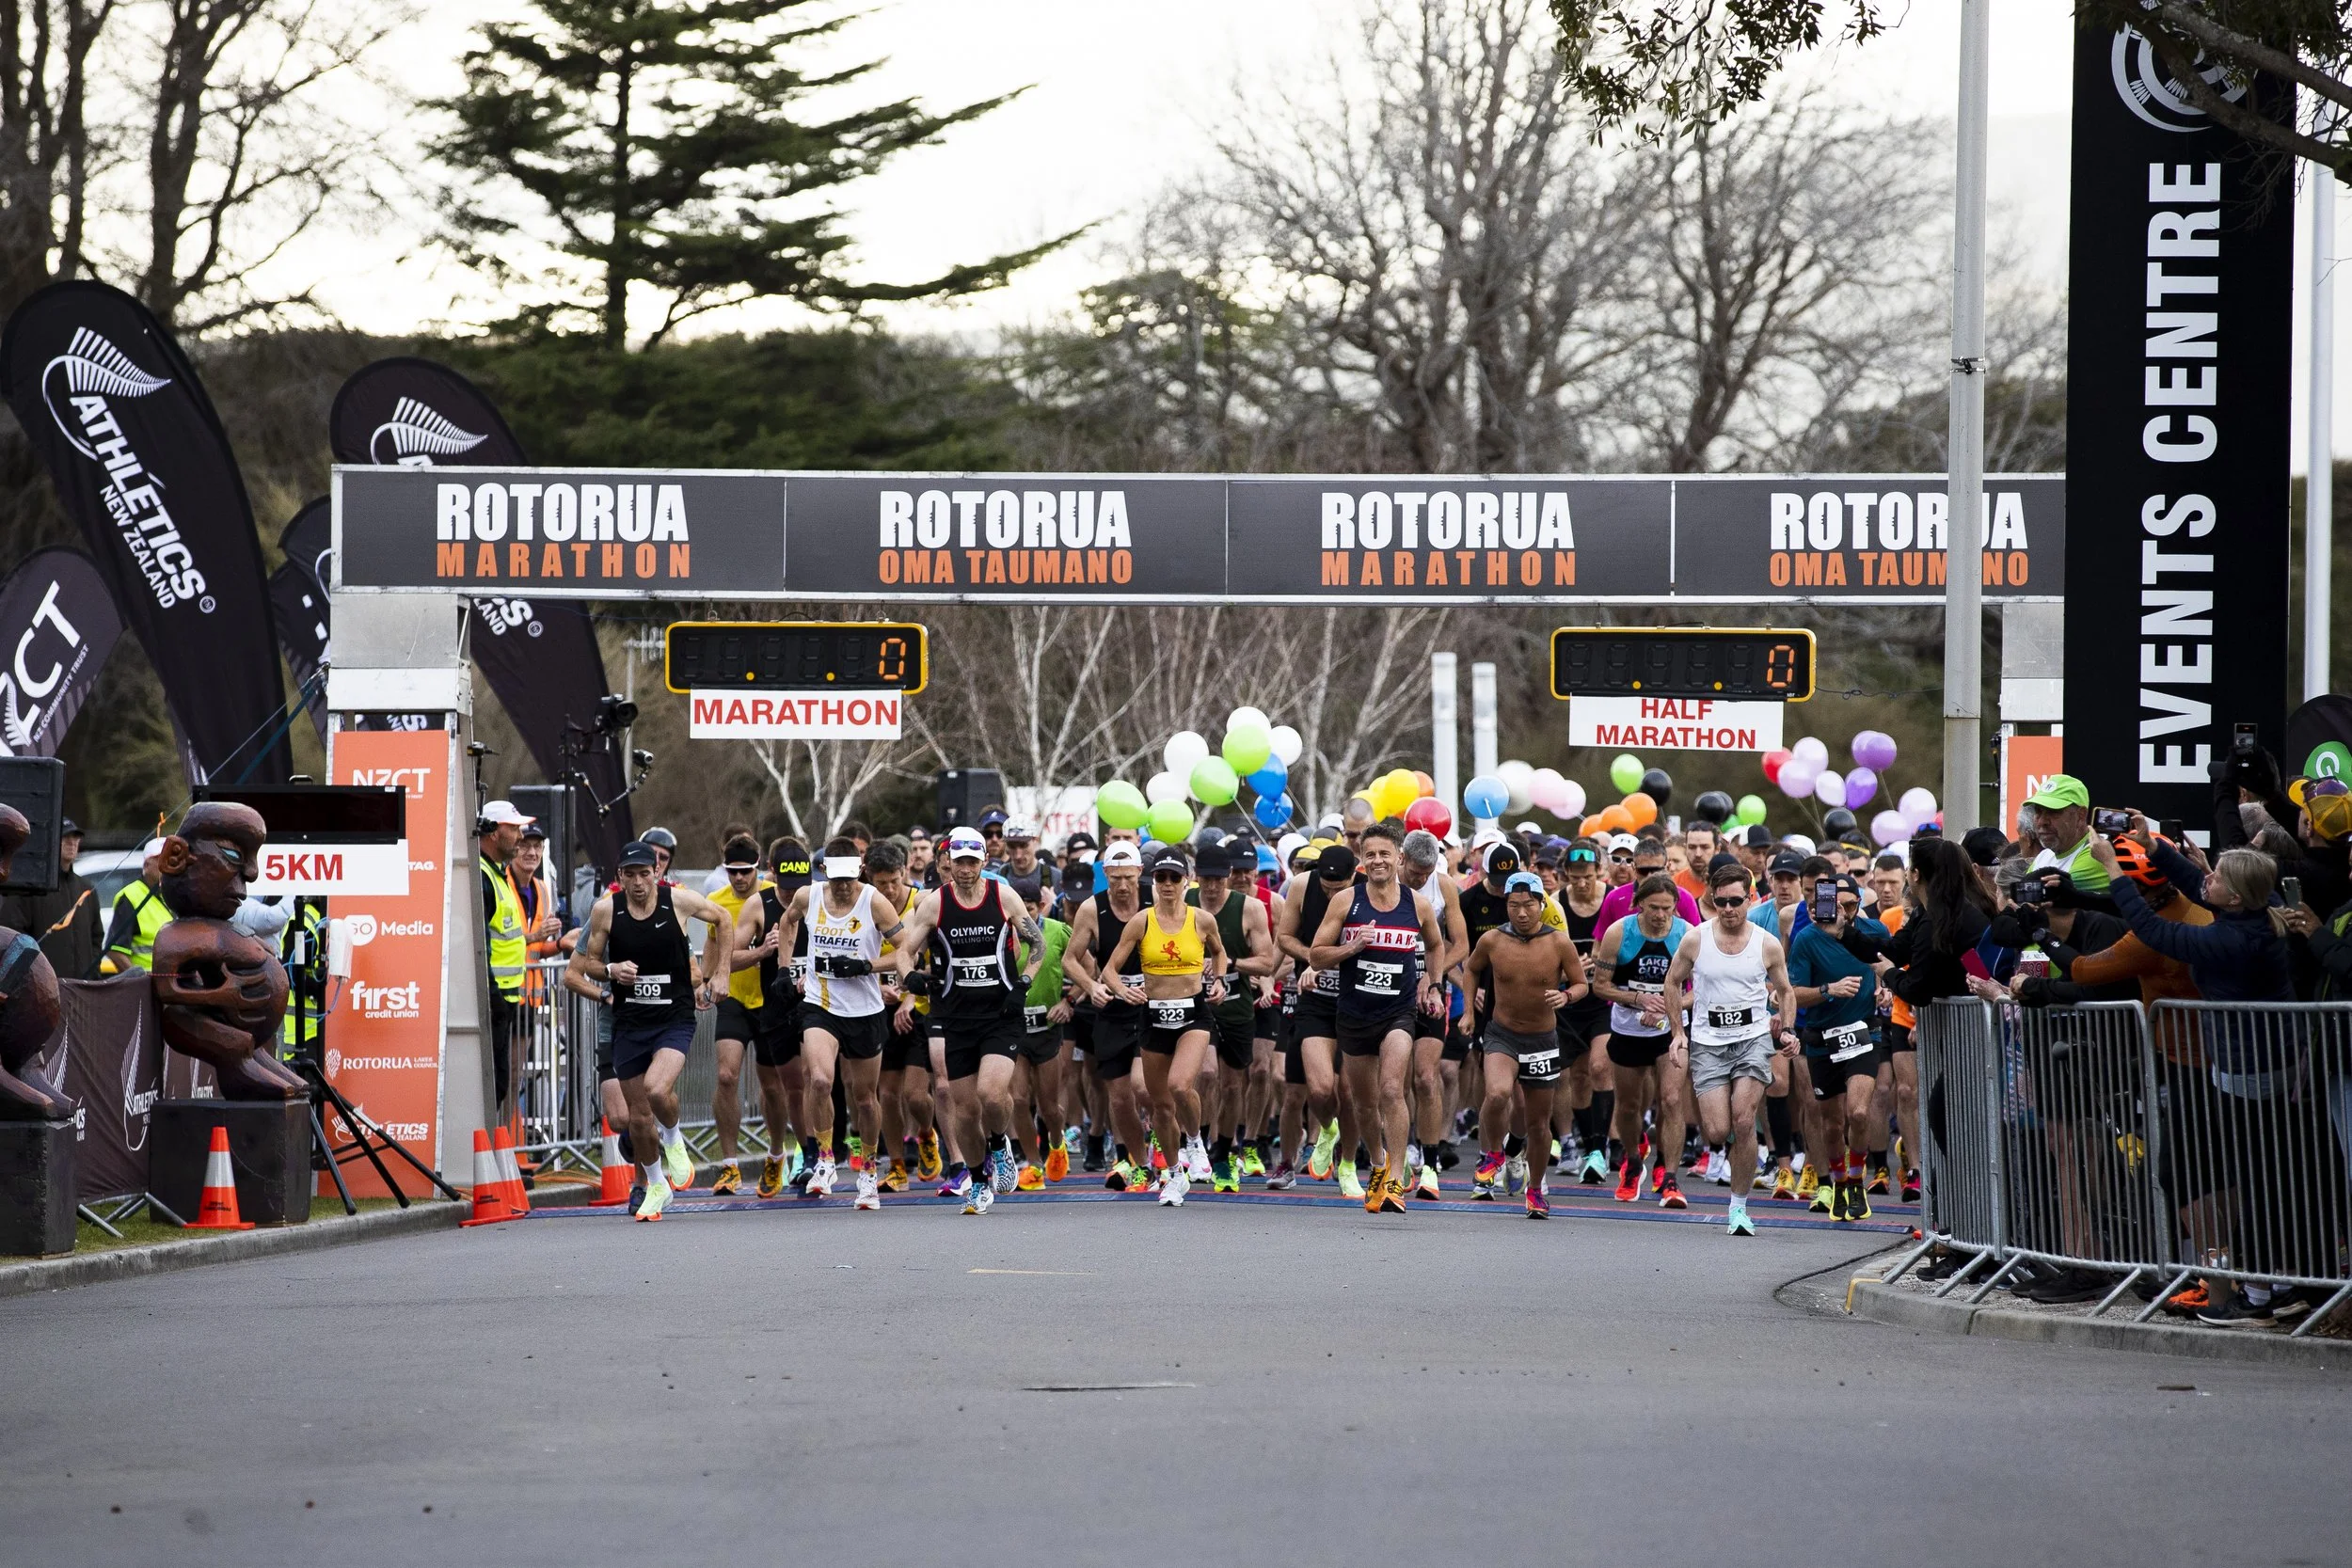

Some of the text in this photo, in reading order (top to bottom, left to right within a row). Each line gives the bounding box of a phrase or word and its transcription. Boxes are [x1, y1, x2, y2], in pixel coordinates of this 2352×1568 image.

[2143, 163, 2221, 463] CENTRE
[437, 483, 690, 542] ROTORUA
[880, 489, 1133, 549] ROTORUA
[1321, 490, 1575, 550] ROTORUA
[100, 483, 176, 610] NEW ZEALAND
[437, 543, 690, 578] MARATHON
[880, 550, 1133, 584] OMA TAUMANO
[1321, 552, 1576, 587] MARATHON
[1771, 552, 2028, 586] OMA TAUMNO
[2139, 494, 2217, 784] EVENTS
[879, 638, 906, 680] 0
[1766, 644, 1795, 688] 0
[41, 672, 73, 729] COMMUNITY
[71, 643, 89, 673] TRUST
[693, 699, 898, 725] MARATHON
[1641, 698, 1713, 721] HALF
[1596, 724, 1756, 750] MARATHON
[265, 854, 342, 881] 5KM
[779, 861, 810, 873] CANN
[381, 920, 434, 936] Media
[814, 926, 846, 937] FOOT
[950, 926, 995, 938] OLYMPIC
[813, 935, 861, 947] TRAFFIC
[951, 935, 995, 944] WELLINGTON
[962, 966, 987, 979] 176
[1638, 966, 1668, 975] CITY
[1639, 958, 1669, 968] LAKE
[1364, 971, 1392, 987] 223
[634, 984, 661, 997] 509
[365, 1010, 420, 1019] credit union
[1159, 1008, 1185, 1022] 323
[1717, 1011, 1742, 1025] 182
[1838, 1032, 1857, 1049] 50
[342, 1056, 412, 1069] ROTORUA
[1529, 1058, 1551, 1074] 531
